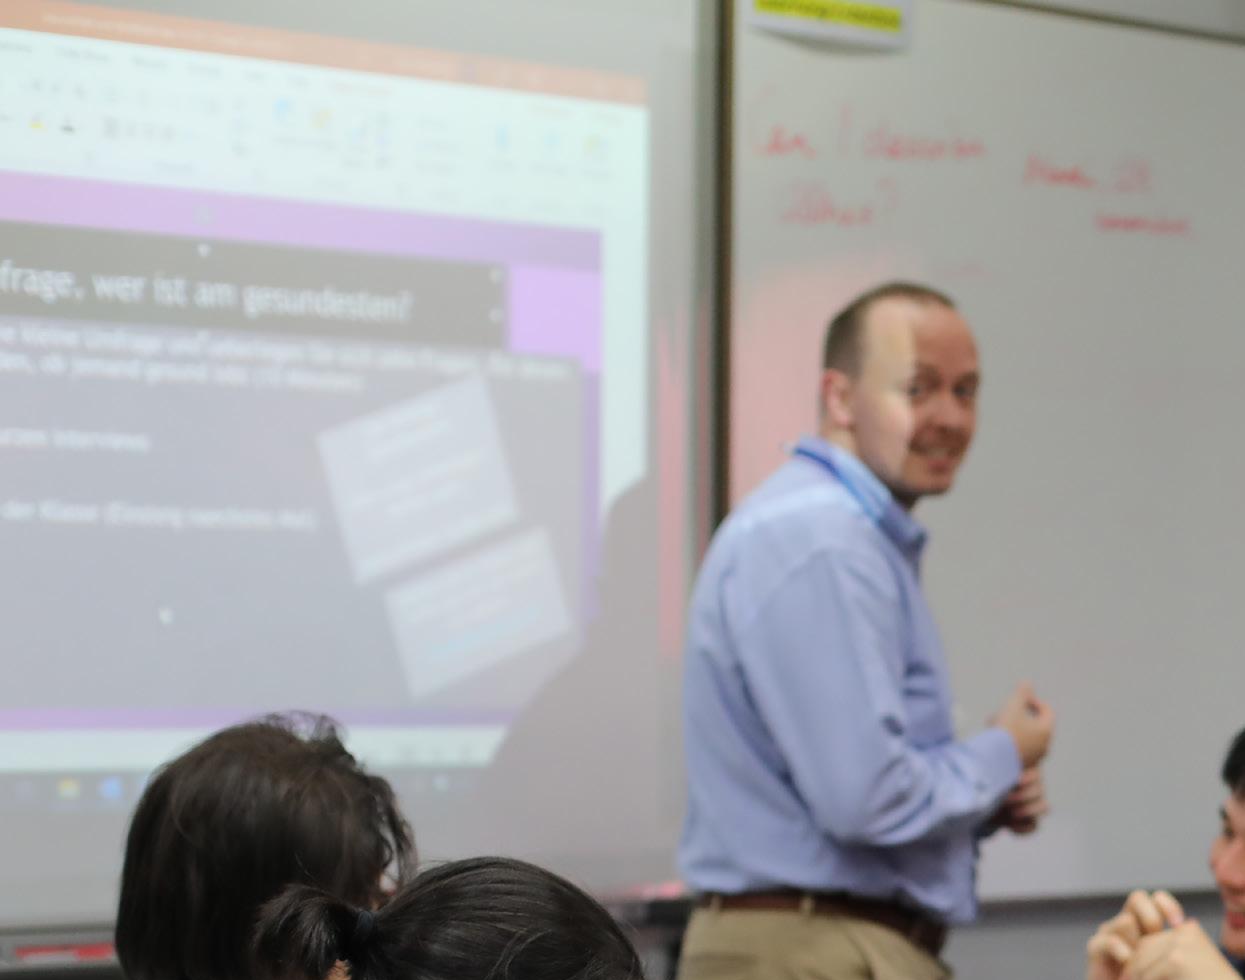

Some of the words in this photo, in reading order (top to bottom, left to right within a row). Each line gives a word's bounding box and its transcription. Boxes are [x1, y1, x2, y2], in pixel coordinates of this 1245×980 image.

[91, 274, 146, 303] wer
[153, 270, 187, 304] ist
[194, 281, 237, 307] am
